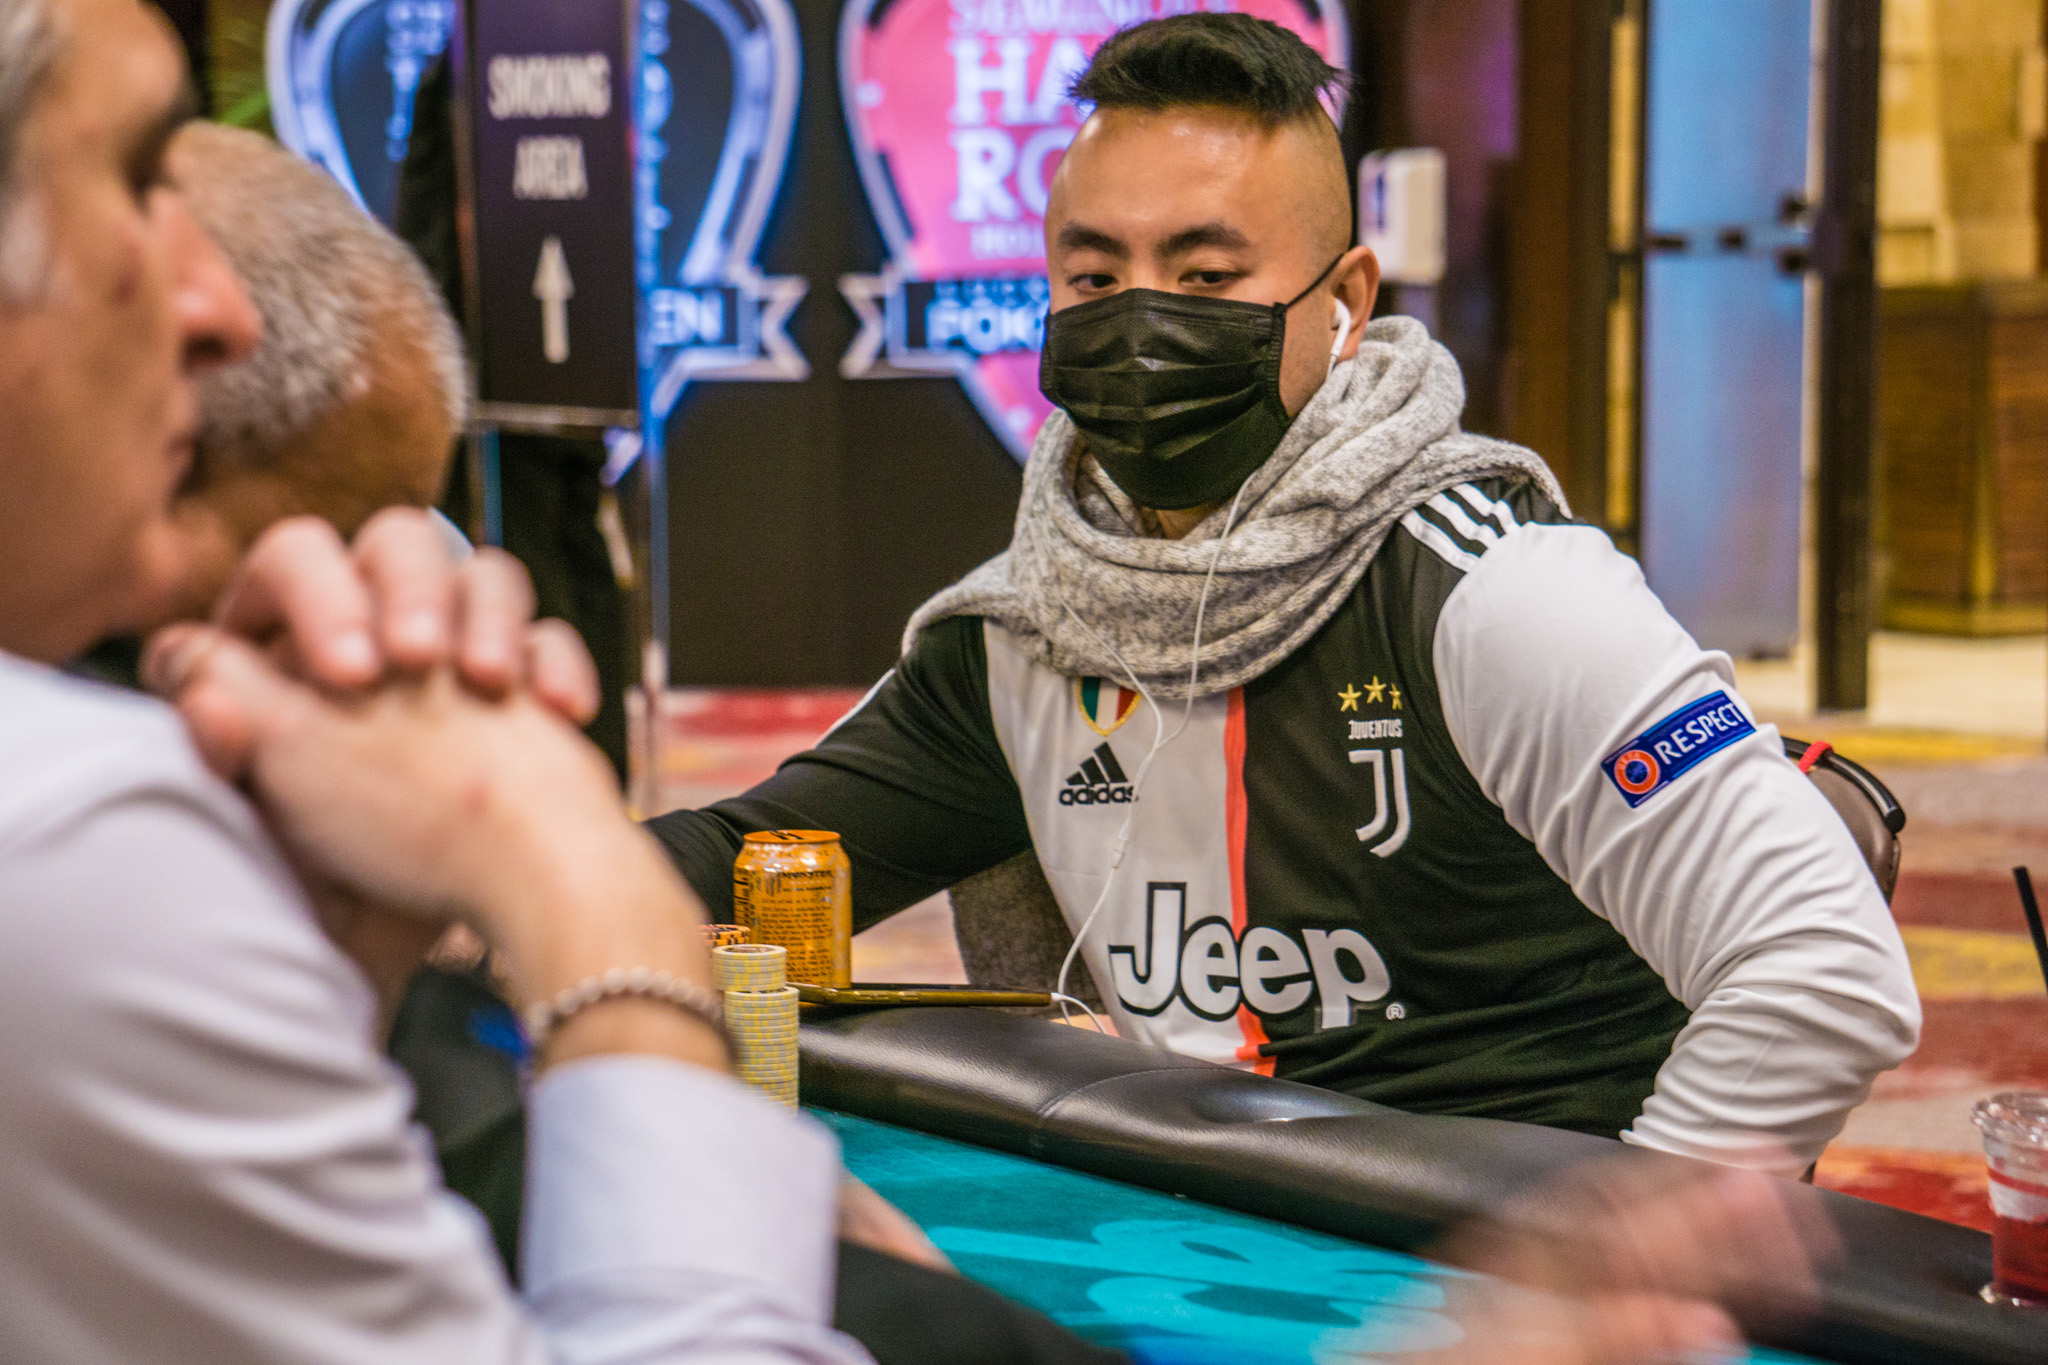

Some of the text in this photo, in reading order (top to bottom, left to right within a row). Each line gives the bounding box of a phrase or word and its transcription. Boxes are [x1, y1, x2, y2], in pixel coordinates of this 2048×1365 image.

[488, 54, 611, 119] SMOKING
[513, 135, 588, 200] AREA
[1348, 718, 1403, 740] JUVENTUS
[1653, 702, 1744, 765] RESPECT
[1058, 783, 1139, 806] adidas
[1108, 882, 1392, 1031] Jeep
